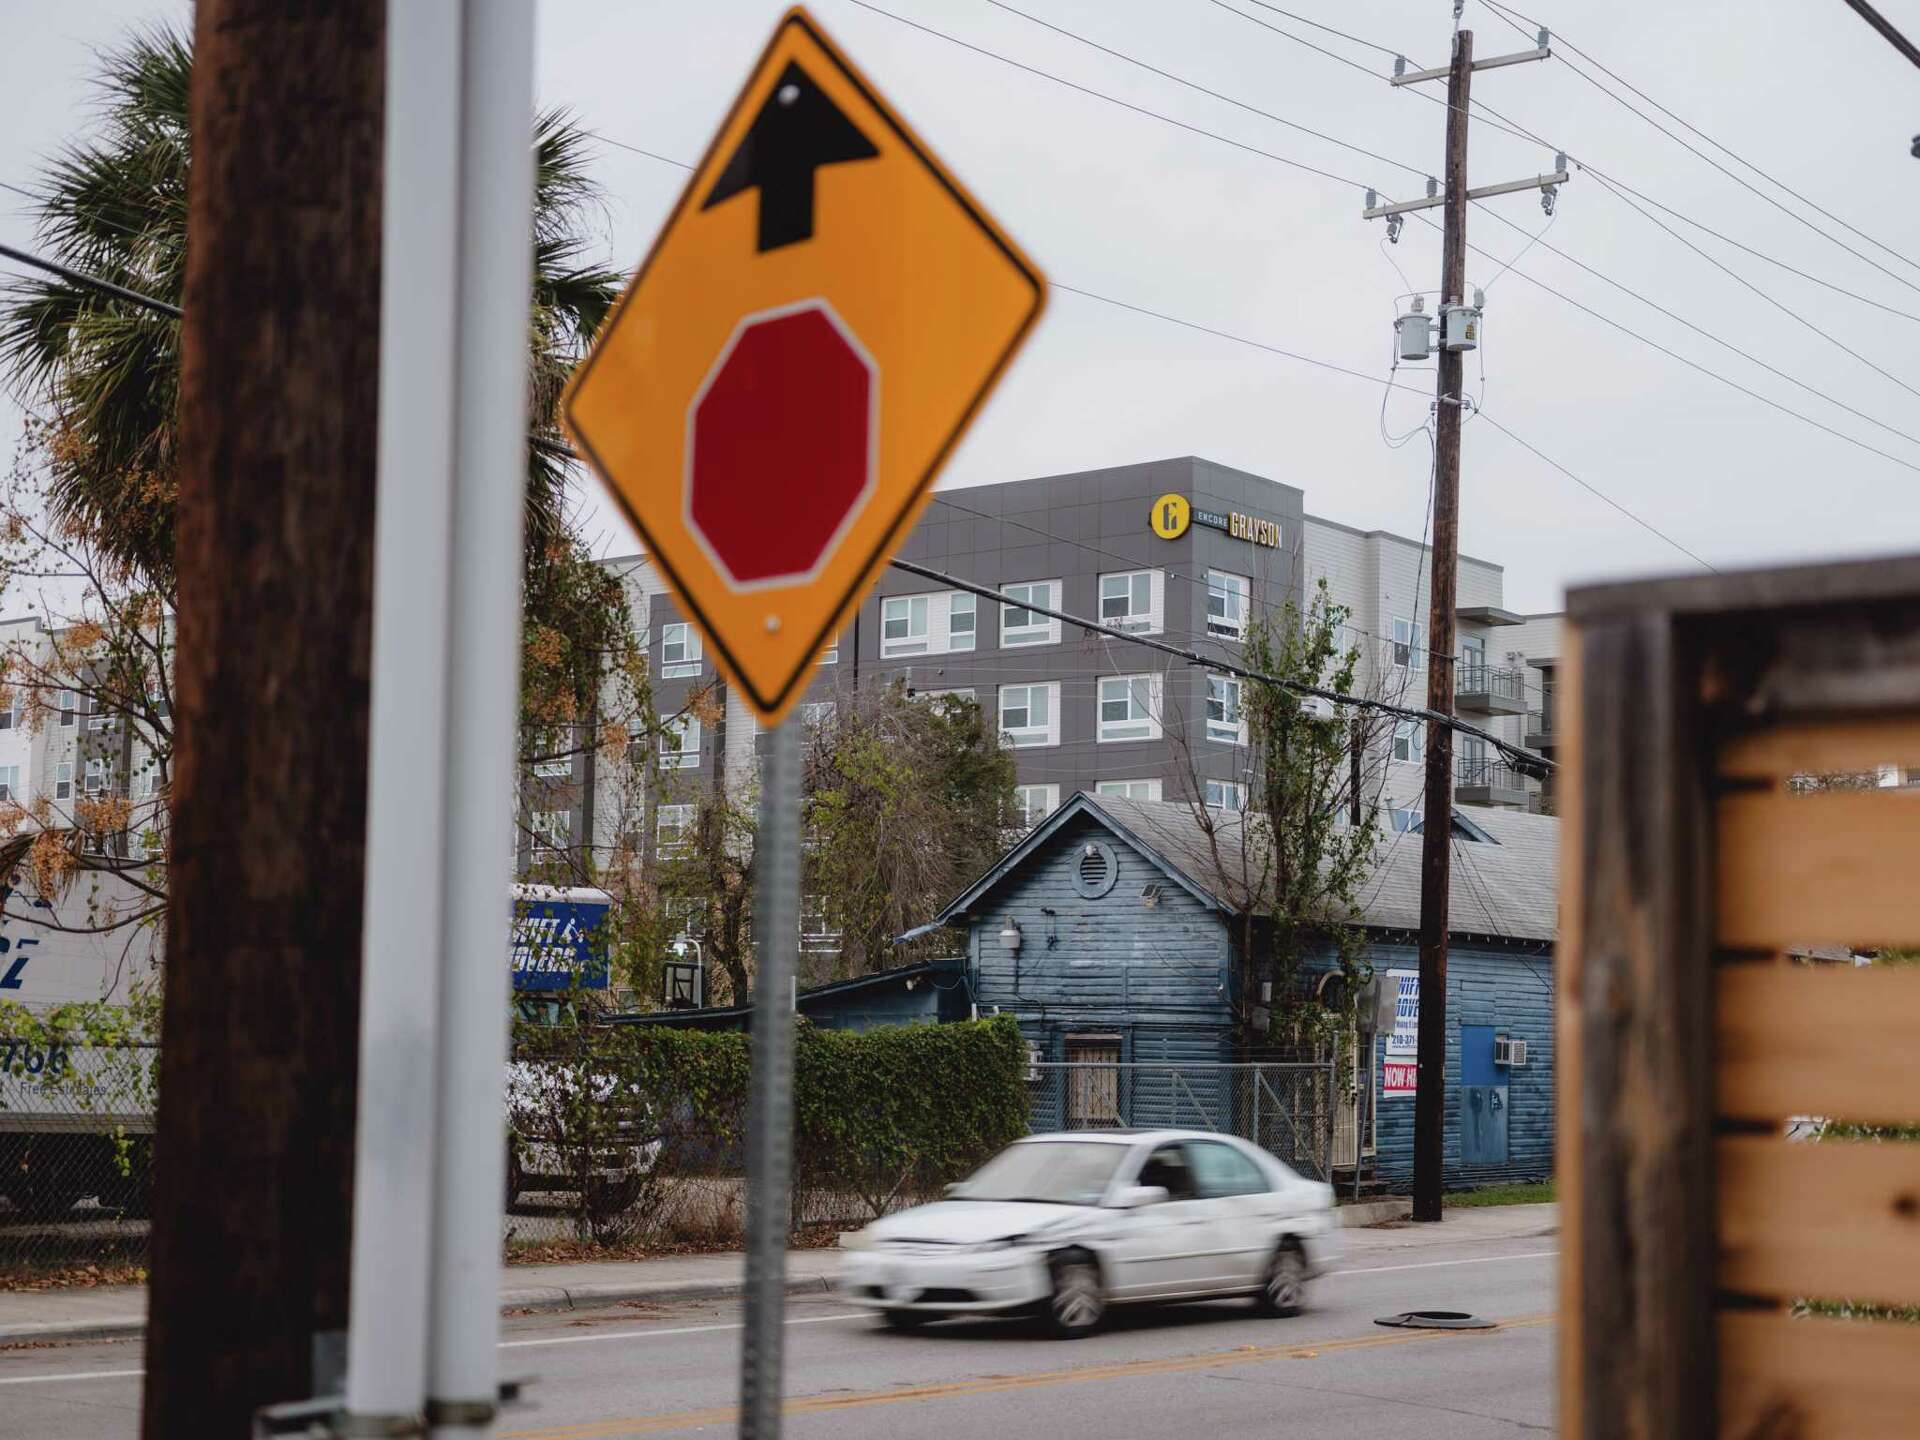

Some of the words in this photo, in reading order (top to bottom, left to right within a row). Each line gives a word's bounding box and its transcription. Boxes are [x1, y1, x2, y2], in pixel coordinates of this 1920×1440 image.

[1198, 511, 1228, 528] ENCORE
[1230, 511, 1283, 548] GRAYSON
[1384, 1067, 1407, 1088] NOW
